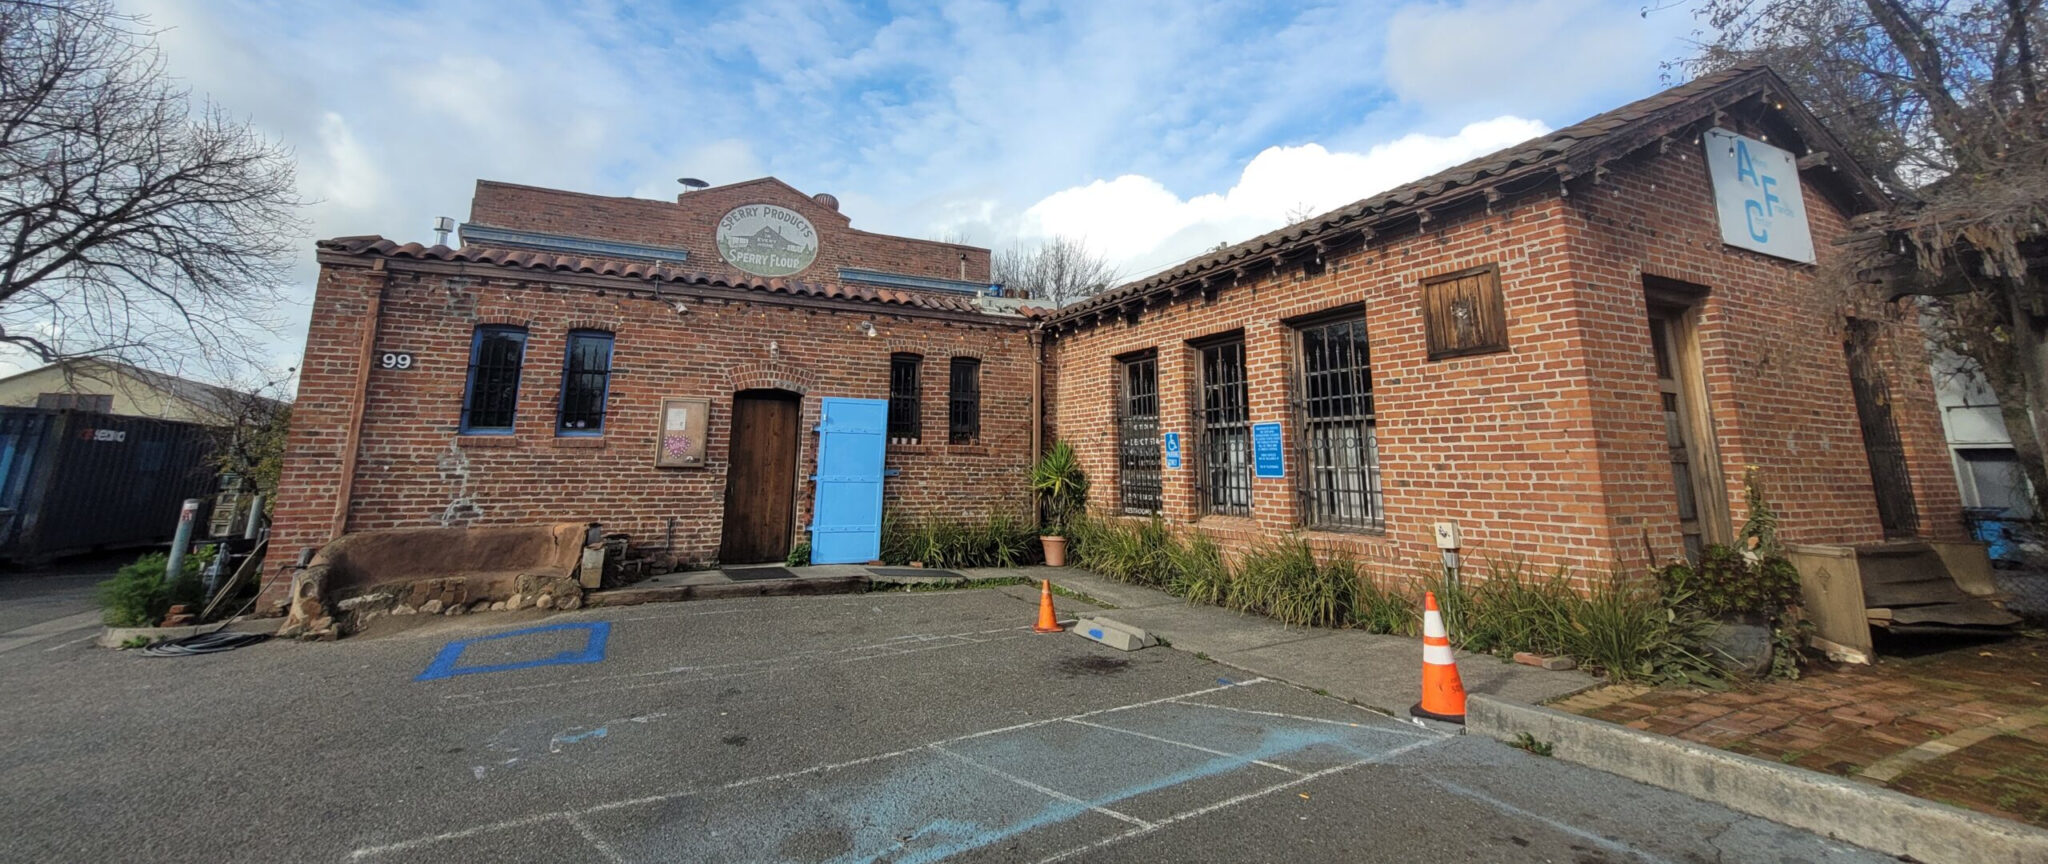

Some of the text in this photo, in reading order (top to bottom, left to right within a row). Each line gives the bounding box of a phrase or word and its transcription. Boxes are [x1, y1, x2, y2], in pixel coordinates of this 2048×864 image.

[1737, 140, 1760, 187] A
[1761, 175, 1779, 217] F
[721, 206, 813, 238] SPERRY PRODUCTS
[1744, 199, 1768, 243] C
[729, 249, 769, 265] SPERRY
[382, 353, 411, 369] 99
